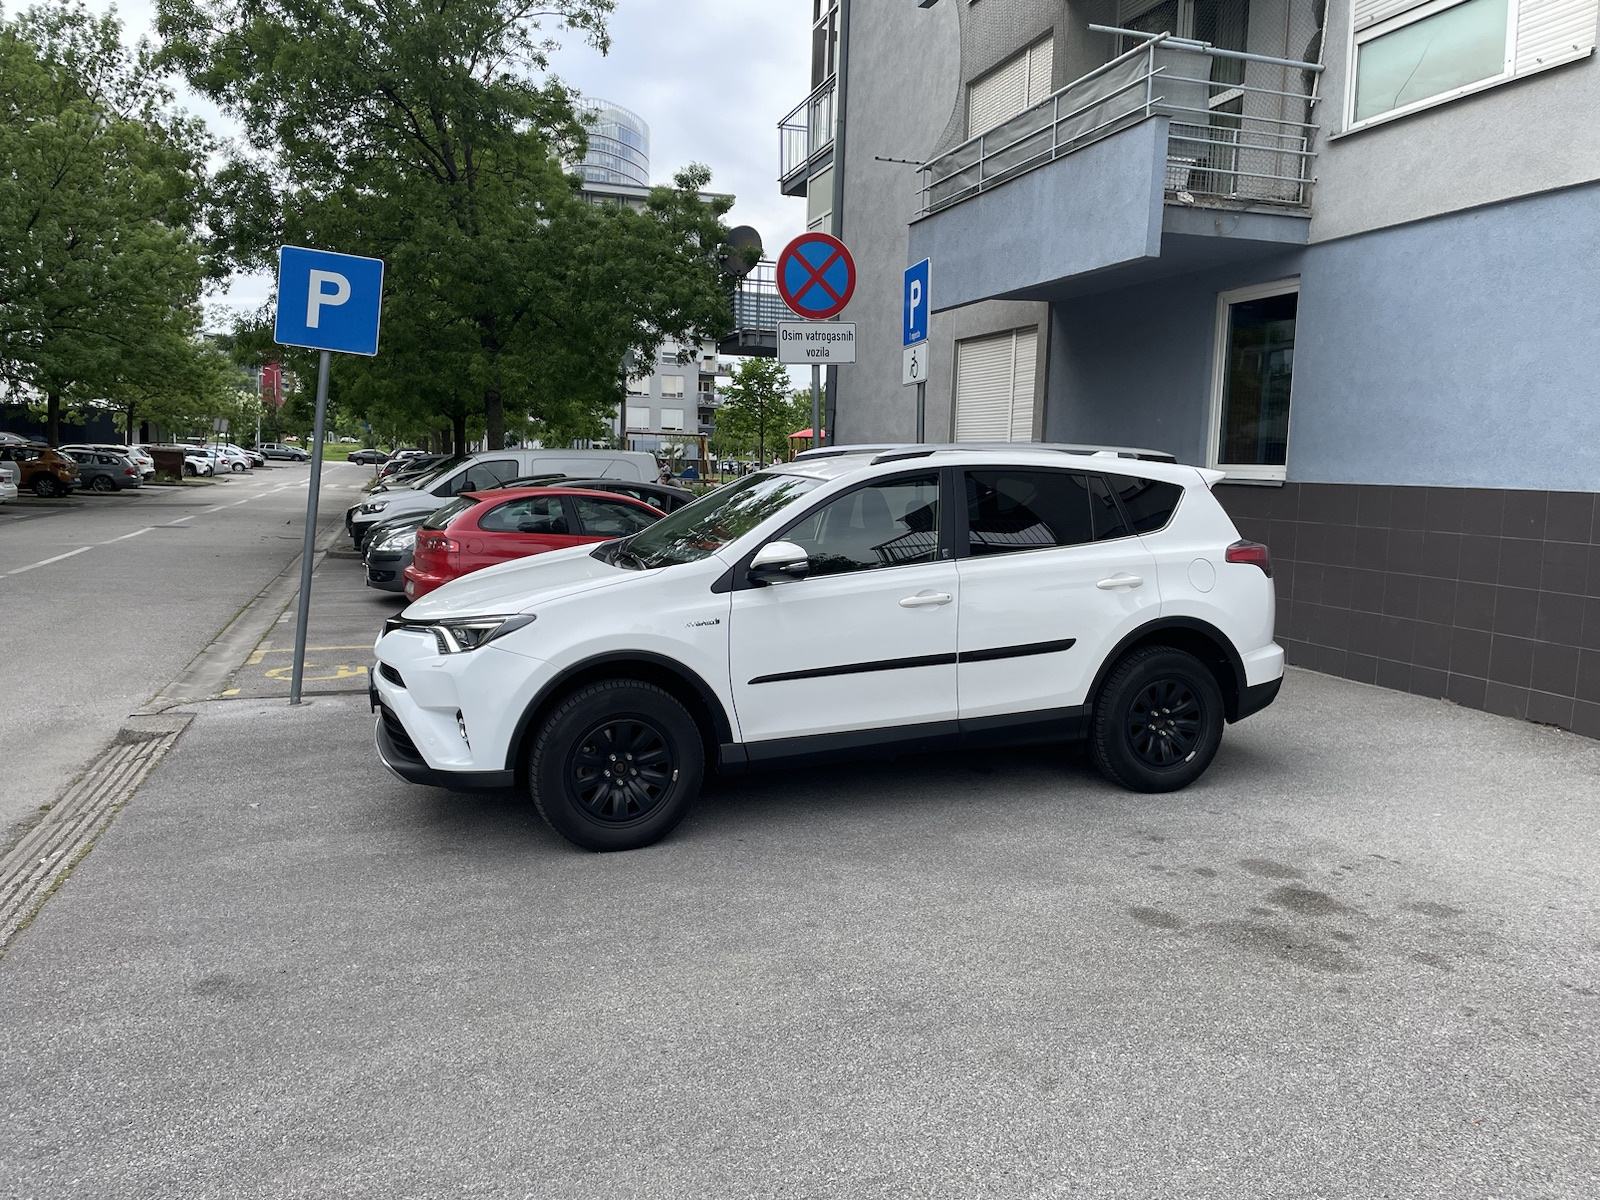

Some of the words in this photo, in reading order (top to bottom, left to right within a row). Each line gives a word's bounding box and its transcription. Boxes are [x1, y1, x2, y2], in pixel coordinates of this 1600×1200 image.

[306, 269, 352, 329] P
[910, 279, 921, 329] P
[782, 329, 803, 341] Osim
[805, 330, 854, 344] vatrogasnih
[806, 346, 830, 357] vozila
